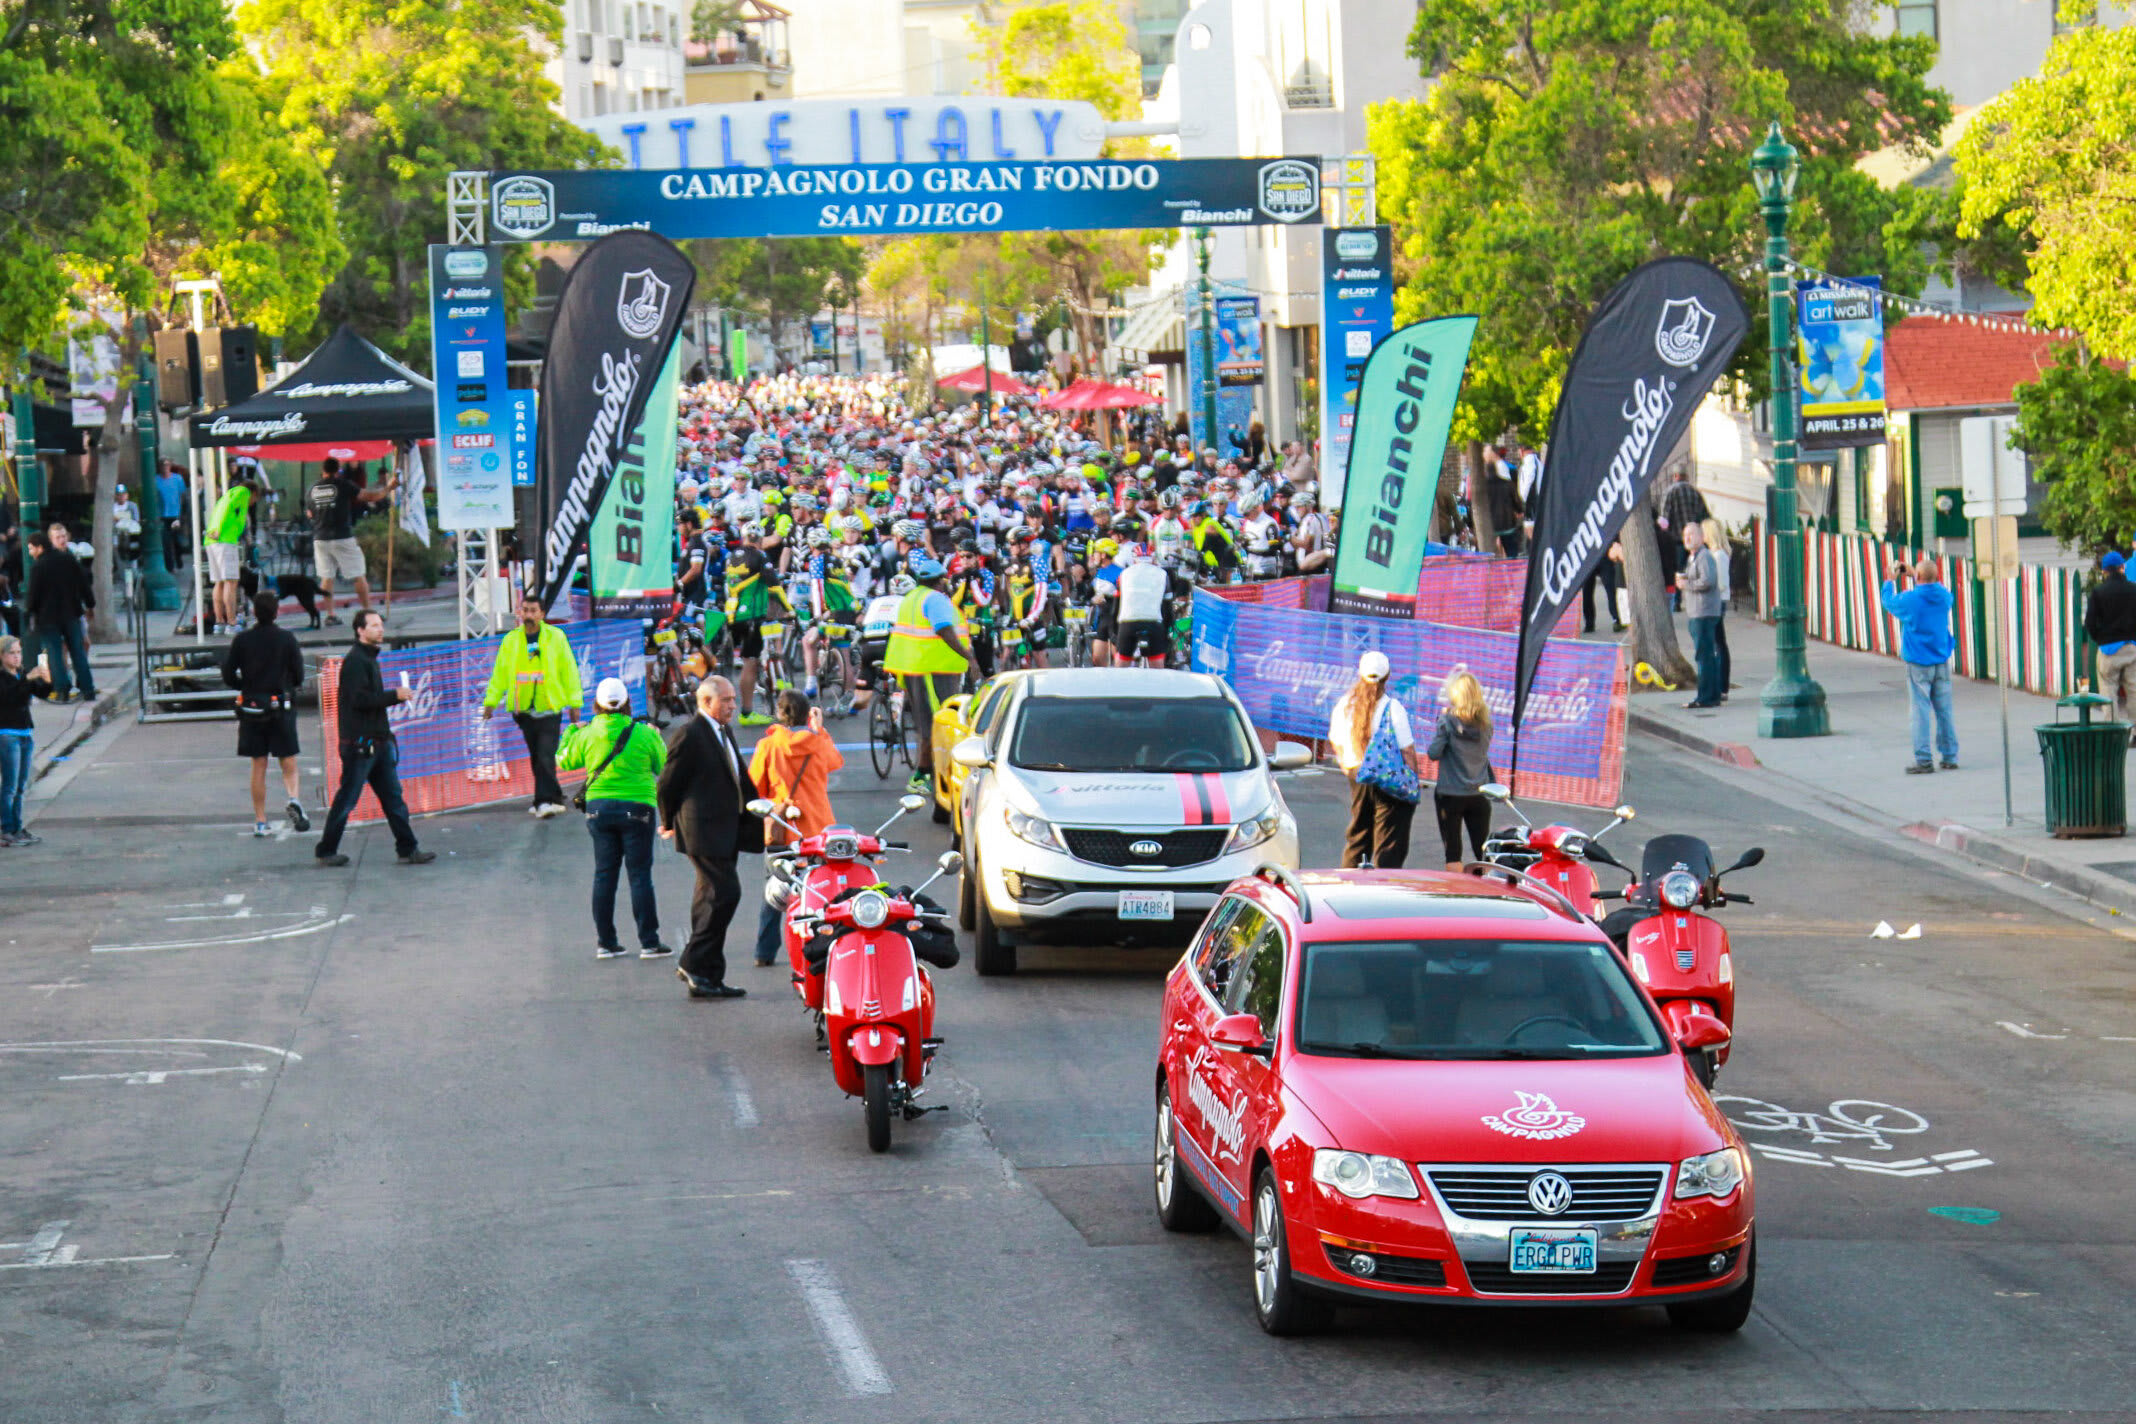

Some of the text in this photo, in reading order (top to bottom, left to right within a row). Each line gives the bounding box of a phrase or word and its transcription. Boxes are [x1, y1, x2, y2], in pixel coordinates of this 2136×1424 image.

[588, 105, 1064, 169] TTLE ITALY
[660, 164, 1160, 200] CAMPAGNOLO GRAN FONDO
[1286, 188, 1312, 202] DIEGO
[521, 204, 547, 219] DIEGO
[818, 202, 1004, 228] SAN DIEGO
[1181, 208, 1253, 223] Bianchi
[1340, 287, 1378, 297] RUDY
[448, 306, 491, 315] RUDY
[273, 379, 413, 399] Campagnolo
[198, 412, 308, 440] Campagnolo
[1806, 417, 1885, 433] APRIL 25 & 26
[1365, 342, 1434, 569] Bianchi
[516, 450, 529, 485] FON
[615, 405, 646, 566] Bian
[1530, 374, 1673, 624] Campagnolo
[1136, 842, 1156, 854] KIA
[1122, 901, 1170, 914] ATR4884
[1562, 1246, 1592, 1267] PWR
